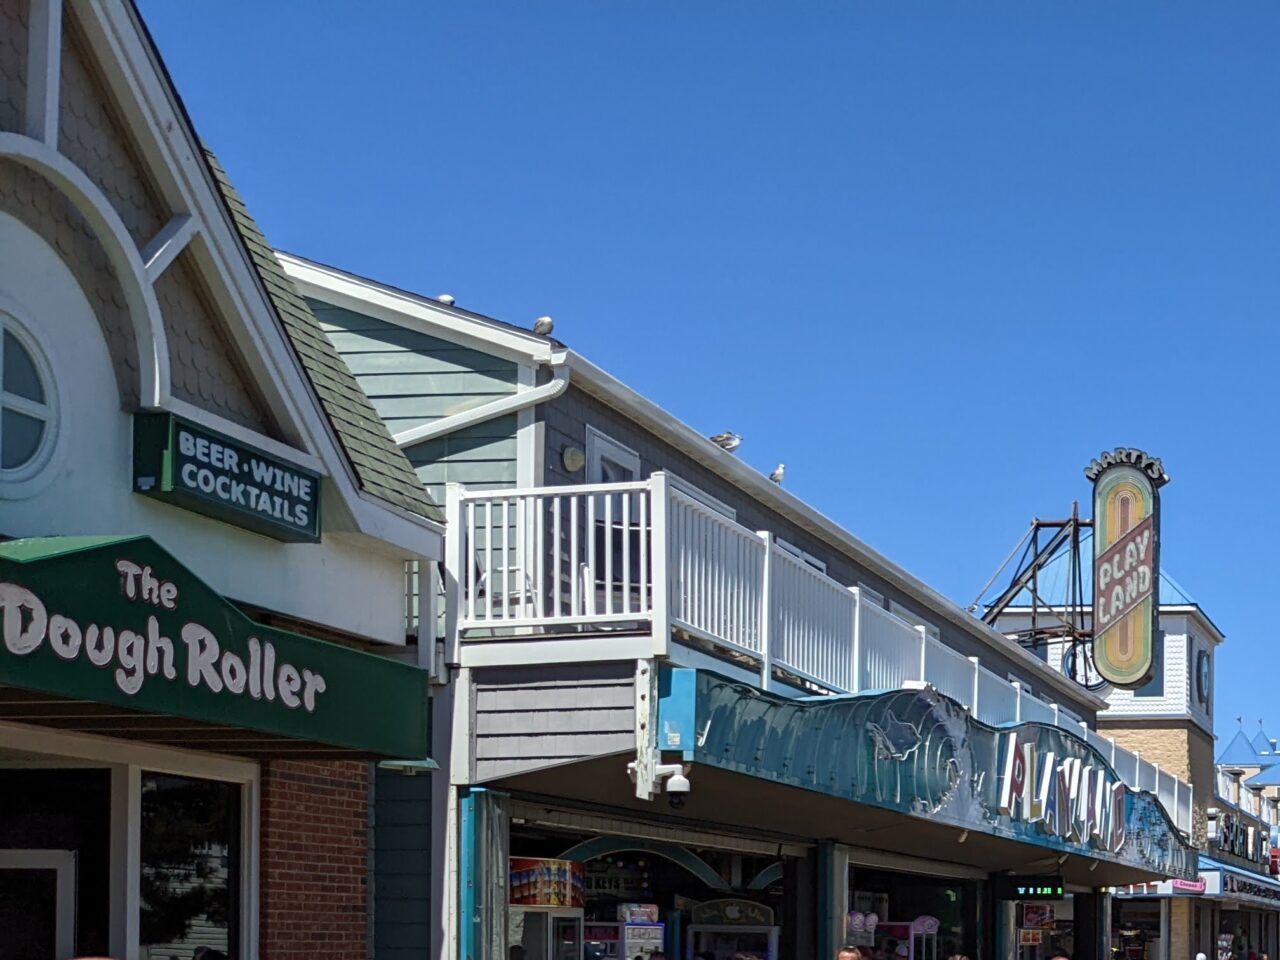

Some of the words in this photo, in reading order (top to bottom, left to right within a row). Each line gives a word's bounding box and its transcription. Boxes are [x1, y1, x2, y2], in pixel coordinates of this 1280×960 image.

[179, 431, 239, 474] BEER
[251, 459, 311, 501] WINE
[1085, 448, 1165, 480] MARTY'S
[181, 463, 309, 527] COCKTAILS
[116, 560, 178, 608] The
[1100, 529, 1150, 590] PLAY
[1099, 565, 1151, 624] LAND
[0, 582, 176, 695] Dough
[181, 622, 327, 713] Roller
